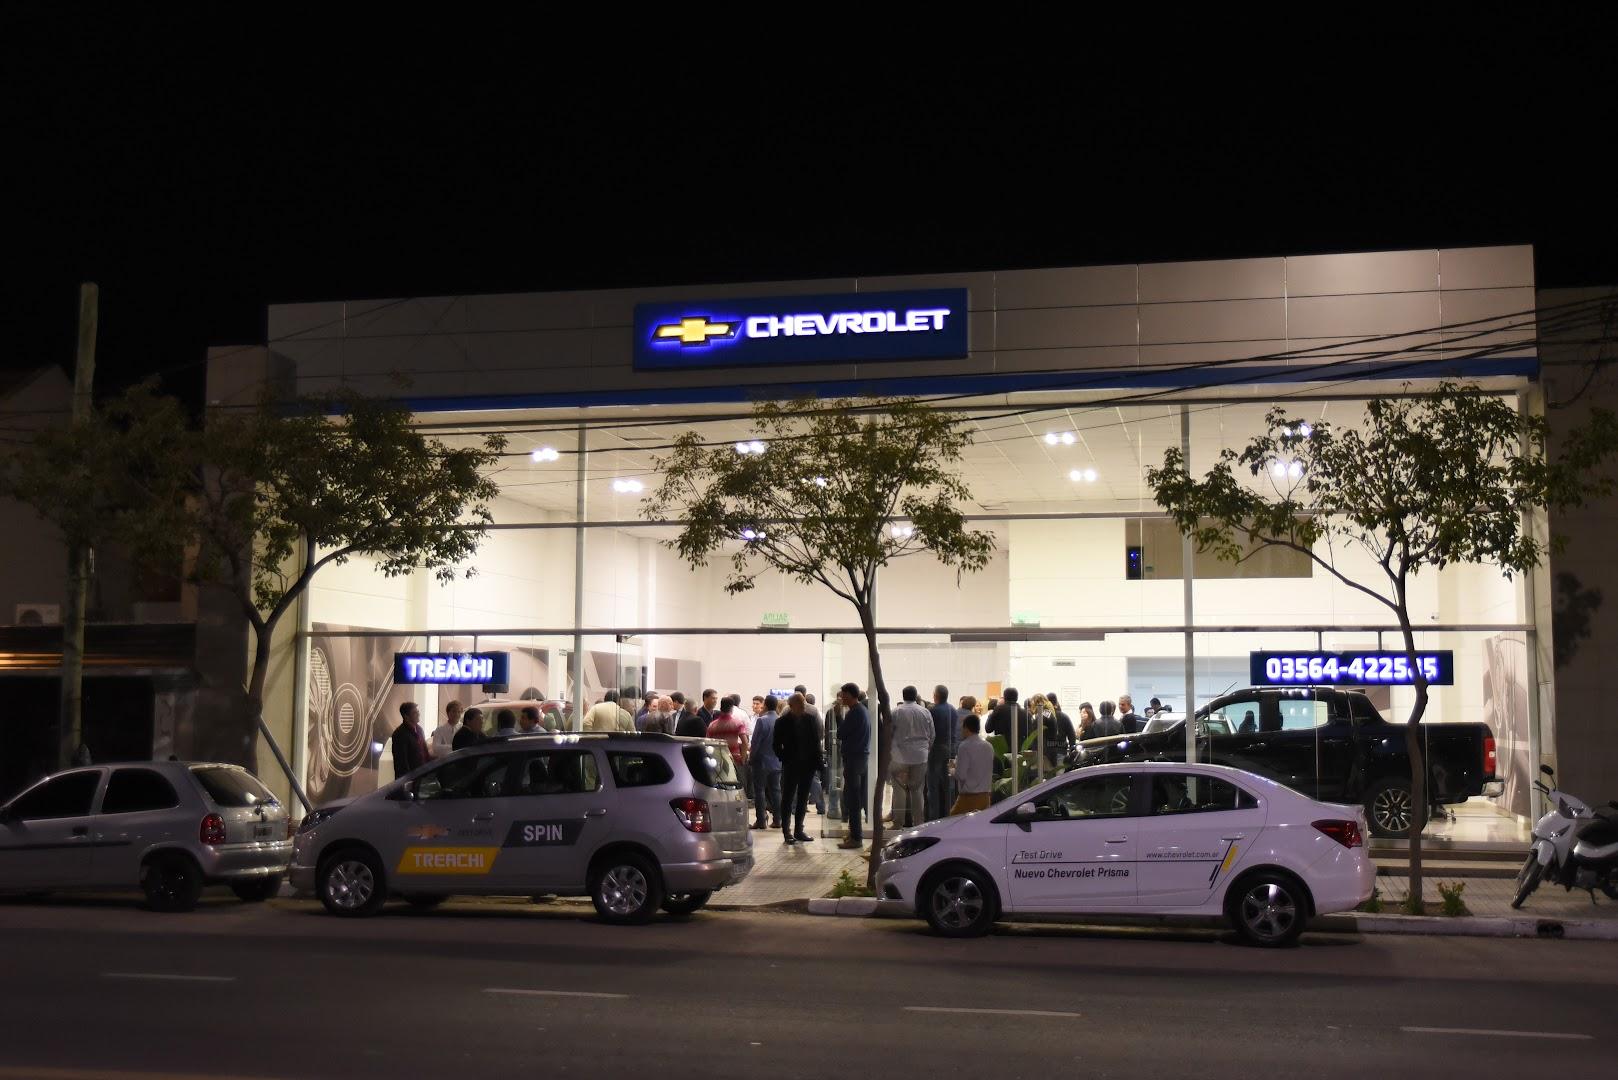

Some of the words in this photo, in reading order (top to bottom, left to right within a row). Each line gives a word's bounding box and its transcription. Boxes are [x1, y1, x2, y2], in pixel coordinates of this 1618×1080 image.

[746, 308, 950, 338] CHEVROLET
[406, 657, 494, 679] TREACHI
[523, 824, 563, 842] SPIN
[413, 853, 484, 868] TREACHI
[1020, 850, 1038, 859] Test
[1040, 850, 1063, 859] Drive
[1014, 869, 1045, 879] Nuevo
[1047, 868, 1095, 878] Chevrolet
[1098, 867, 1130, 877] Prisma
